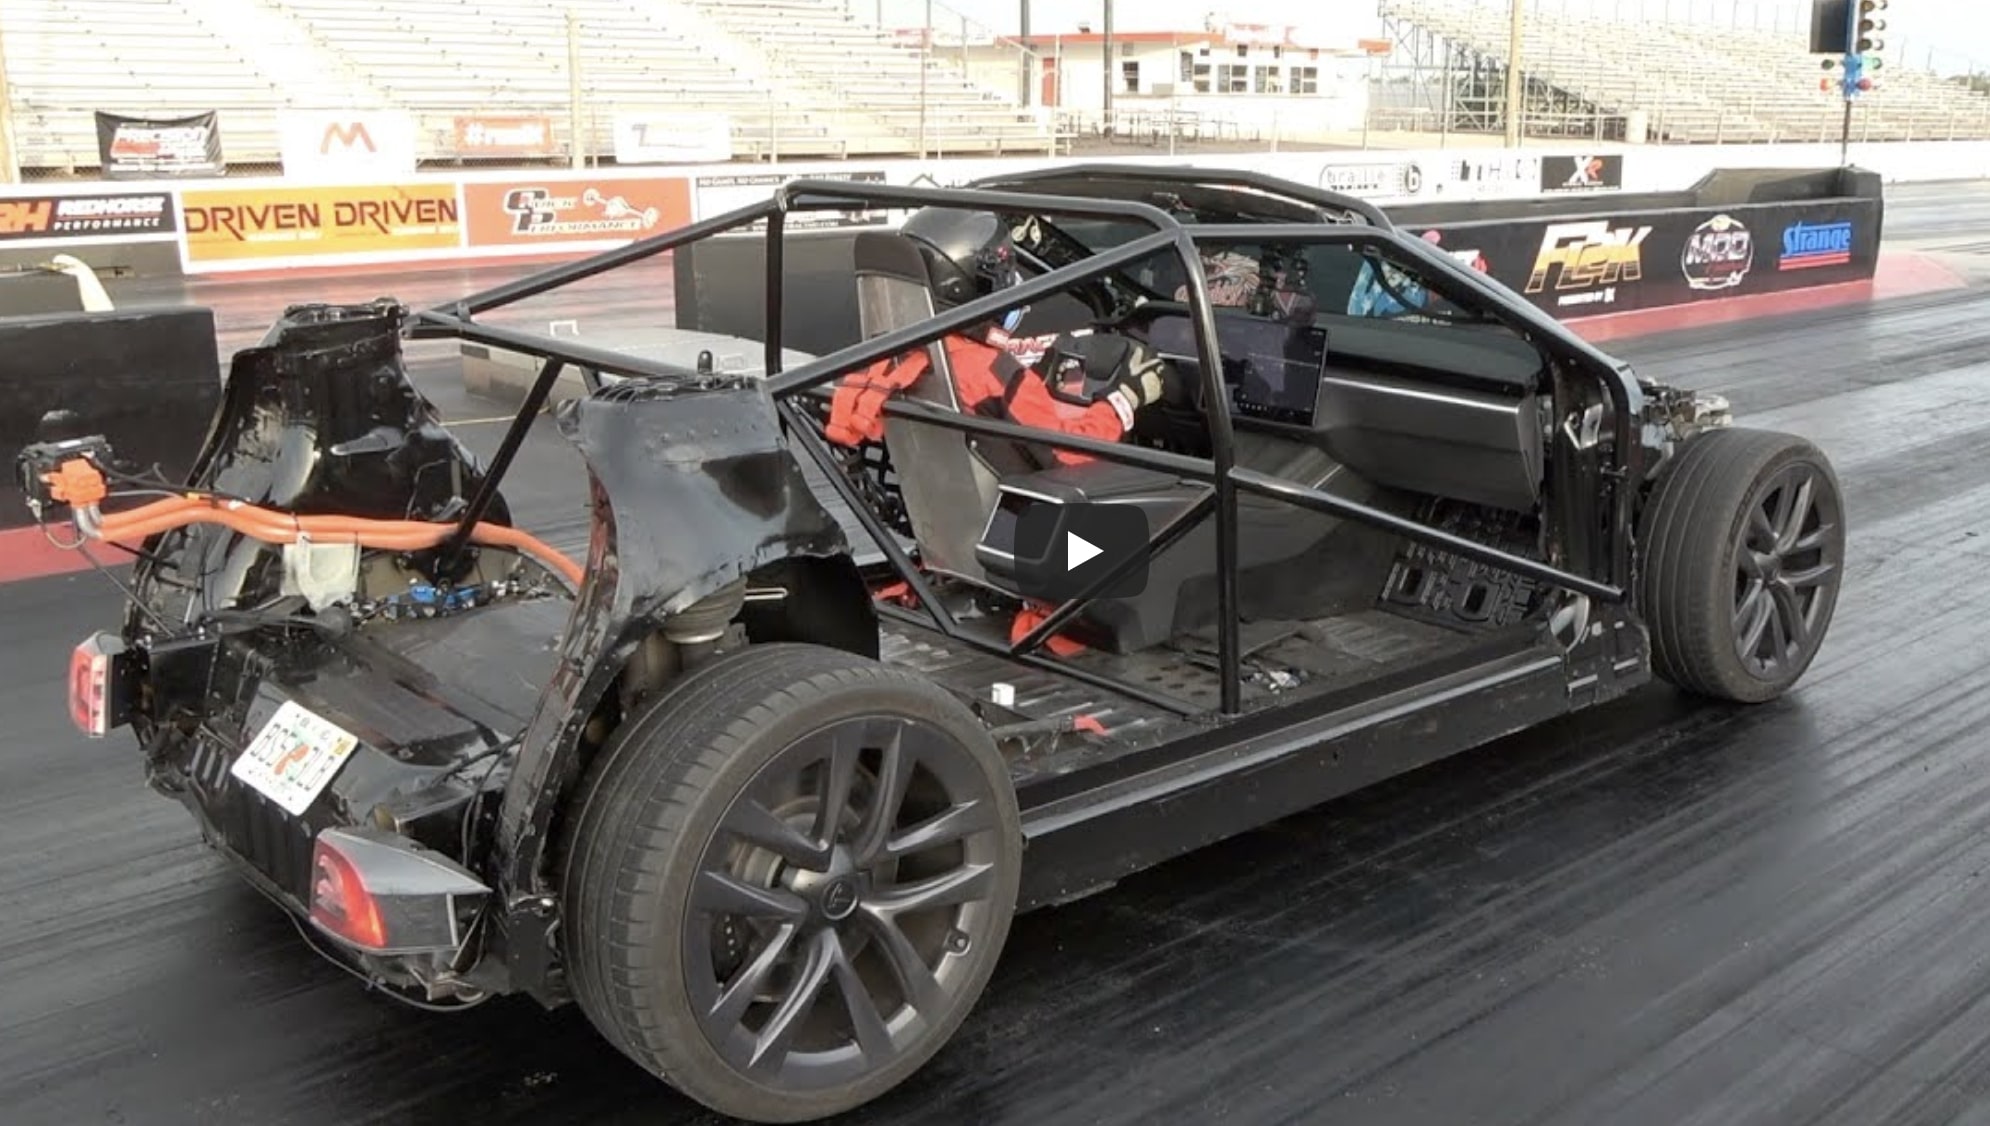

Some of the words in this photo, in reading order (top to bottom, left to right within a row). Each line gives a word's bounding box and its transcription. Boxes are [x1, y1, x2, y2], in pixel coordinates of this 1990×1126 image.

[53, 217, 160, 231] PERFORMANCE
[184, 202, 320, 241] DRIVEN
[335, 197, 458, 235] DRIVEN
[1783, 221, 1850, 254] Strange
